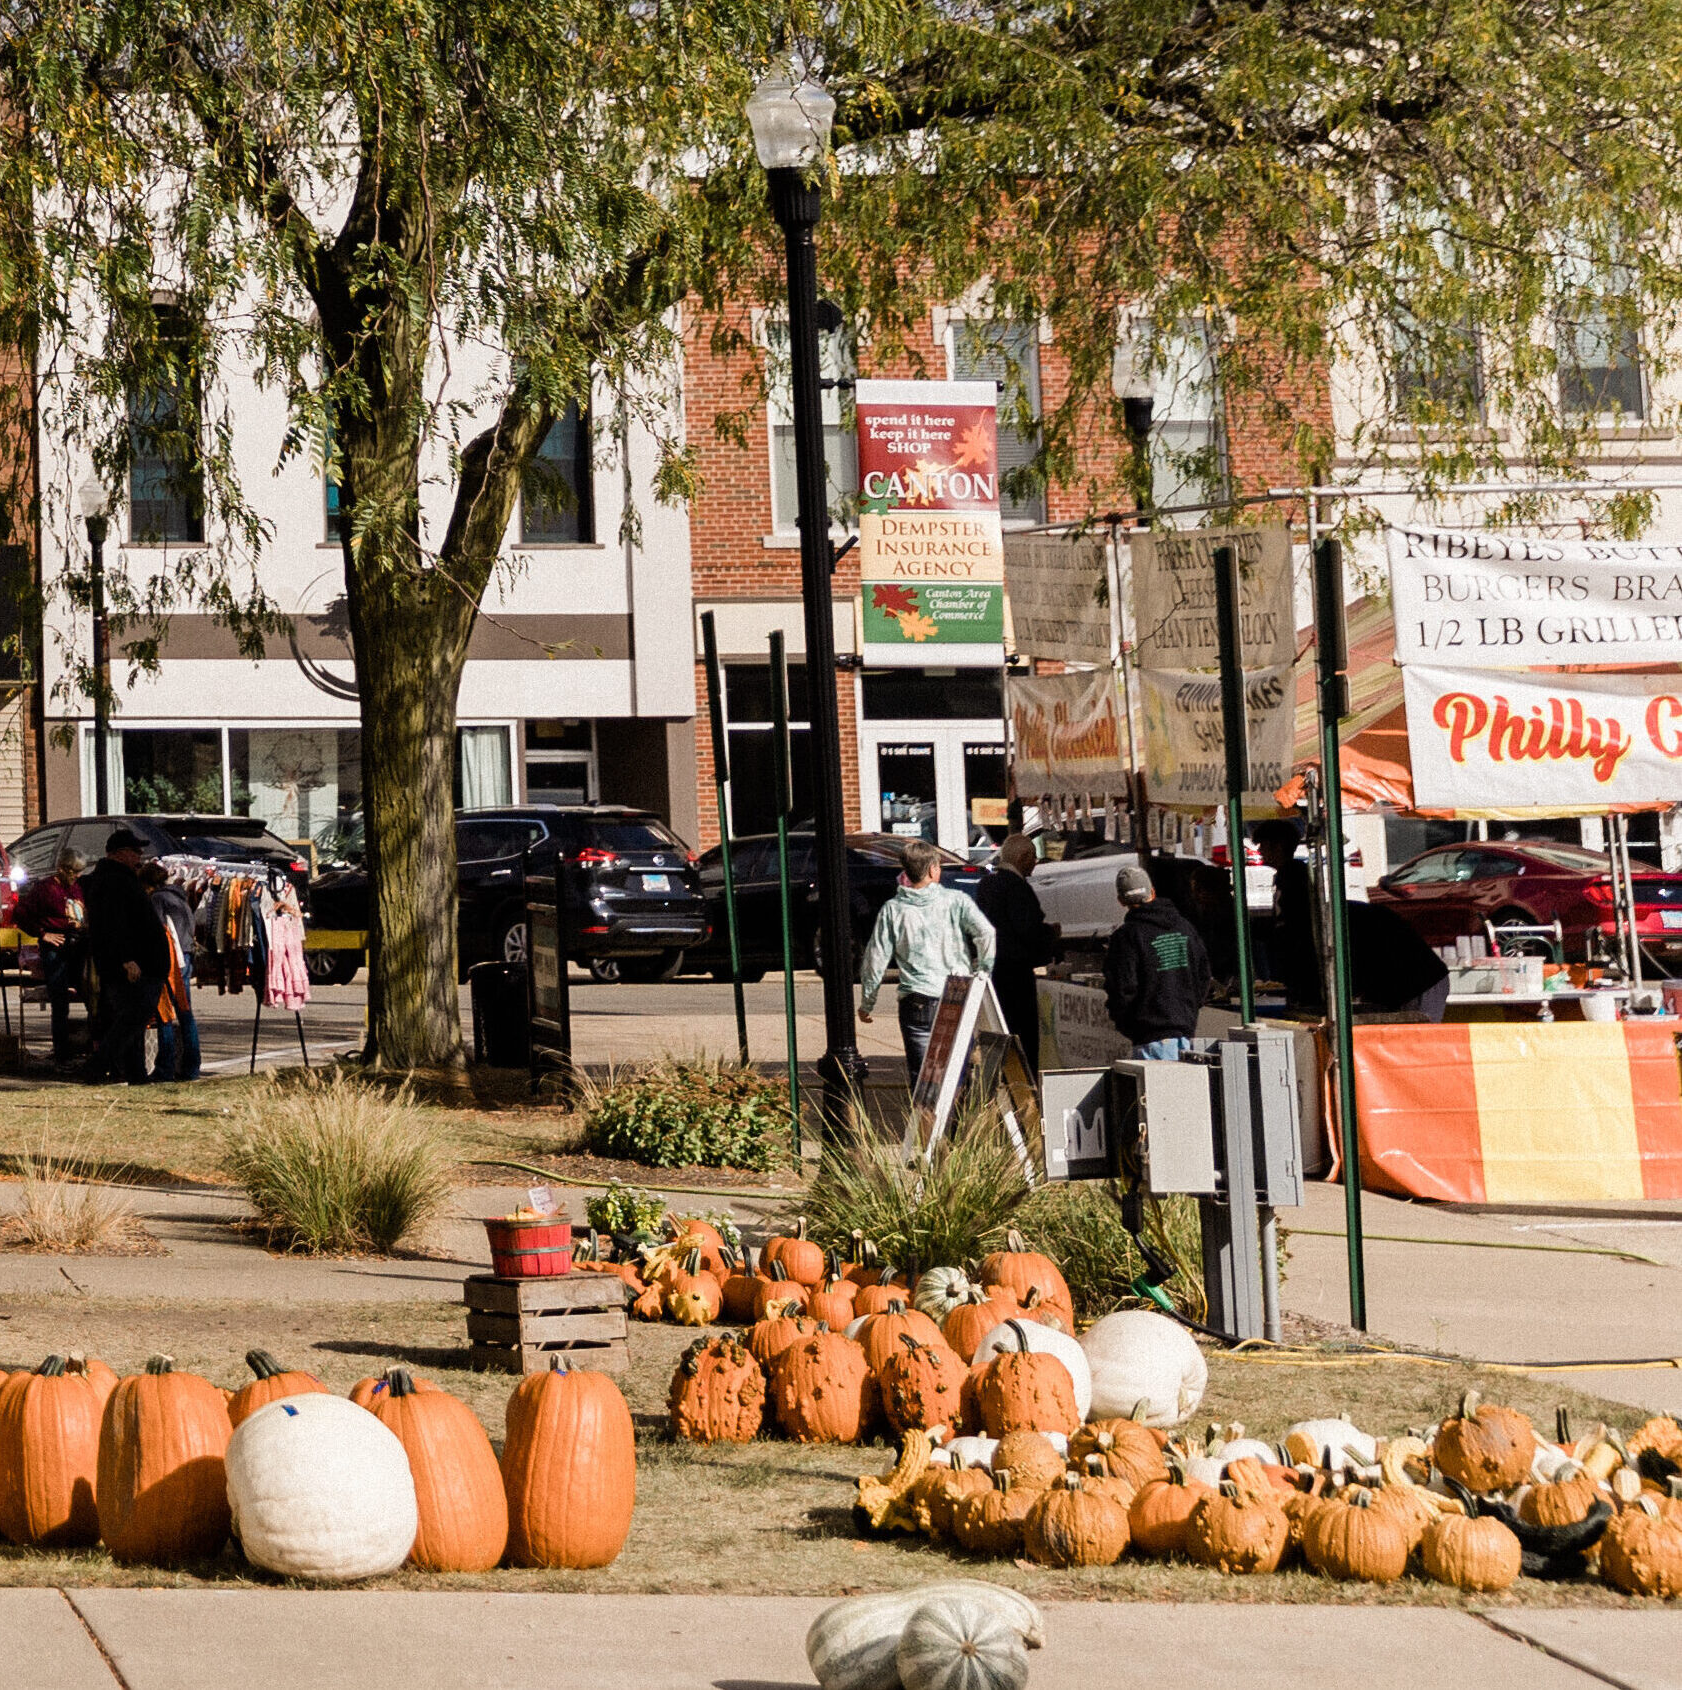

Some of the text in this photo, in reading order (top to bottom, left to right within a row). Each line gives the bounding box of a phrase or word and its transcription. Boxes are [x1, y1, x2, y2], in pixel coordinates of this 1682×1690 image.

[865, 414, 955, 428] spend it here
[870, 428, 951, 442] keep it here
[887, 442, 932, 454] SHOP
[863, 471, 995, 499] CANTON
[881, 519, 986, 536] DEMPSTER
[876, 539, 992, 556] INSURANCE
[893, 560, 976, 576] AGENCY
[1424, 574, 1590, 602] BURGERS
[1416, 619, 1465, 650] 1/2
[1478, 617, 1524, 646] LB
[1432, 691, 1632, 783] Philly
[1251, 762, 1282, 792] DOGS
